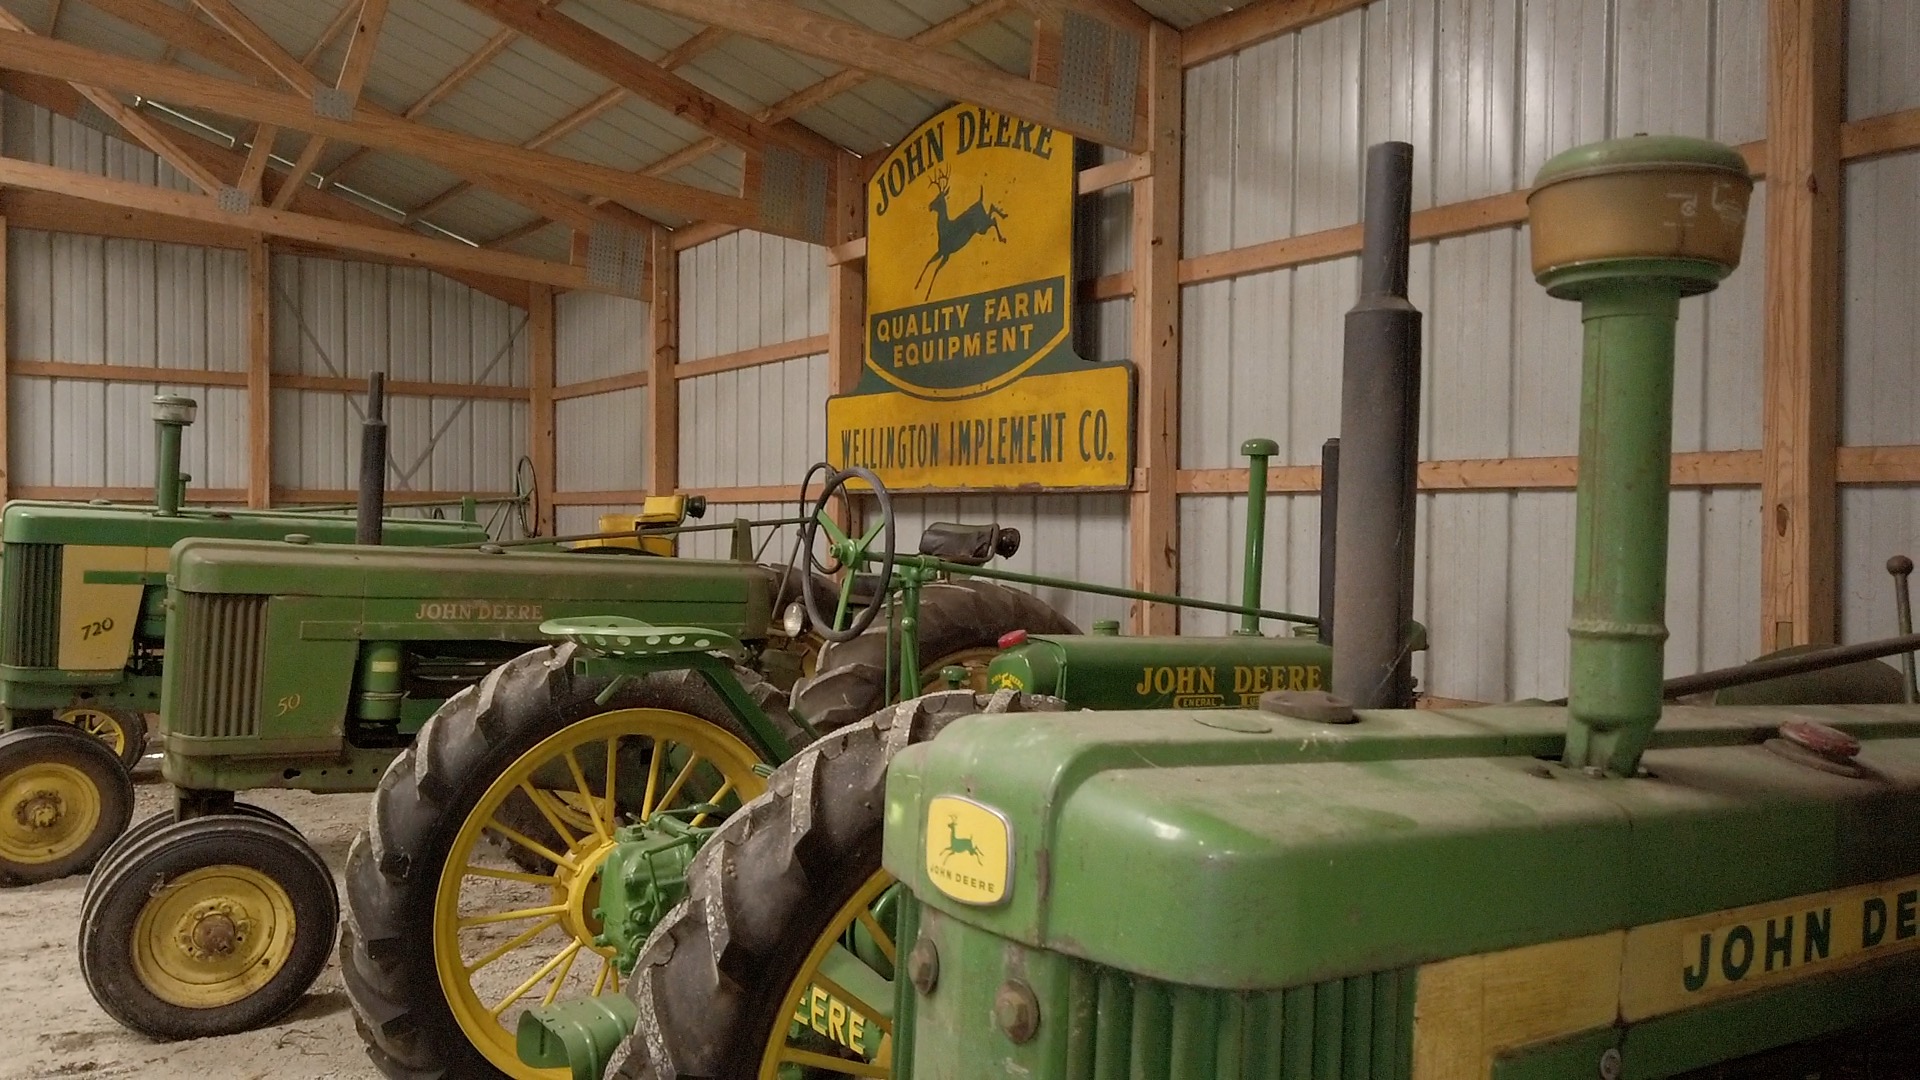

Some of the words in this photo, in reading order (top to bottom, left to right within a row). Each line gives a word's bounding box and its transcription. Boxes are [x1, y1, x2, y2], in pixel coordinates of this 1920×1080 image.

[876, 121, 945, 216] JOHN
[956, 108, 1054, 160] DEERE
[876, 303, 970, 343] QUALITY
[984, 287, 1054, 322] FARM
[893, 324, 1034, 368] EQUIPMENT
[841, 422, 940, 470] WELLINGTON
[949, 412, 1066, 466] IMPLEMENT
[1078, 409, 1115, 462] CO.
[81, 617, 114, 640] 720
[415, 603, 472, 619] JOHN
[479, 605, 543, 620] DEERE
[1136, 666, 1216, 695] JOHN
[1233, 665, 1322, 693] DEERE
[275, 693, 301, 717] 50
[930, 864, 952, 880] JOHN
[955, 873, 995, 893] DEERE
[1683, 908, 1832, 992] JOHN
